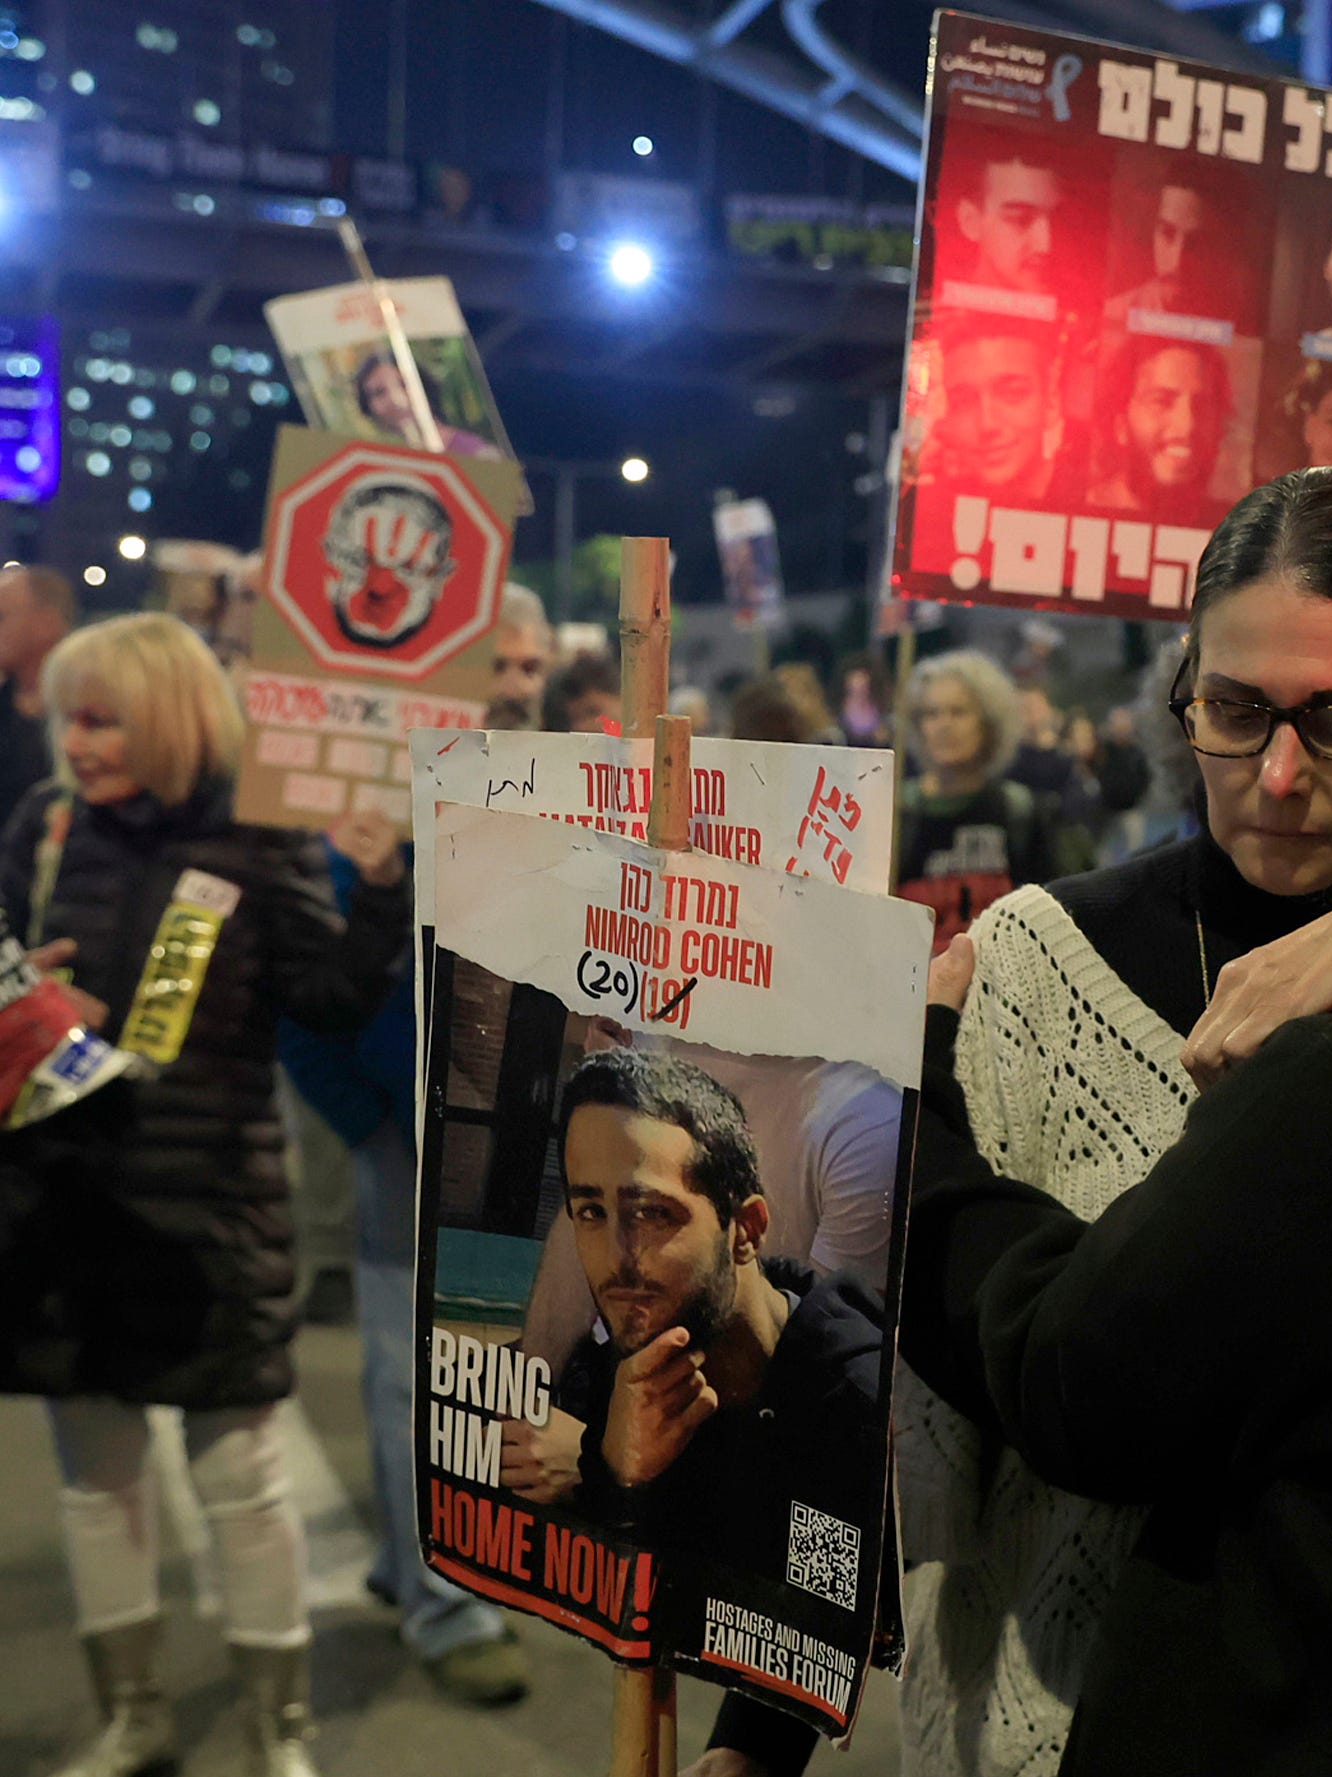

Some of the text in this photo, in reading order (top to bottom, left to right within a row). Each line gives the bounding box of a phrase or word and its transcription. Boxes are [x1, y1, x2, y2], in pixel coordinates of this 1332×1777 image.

[1098, 59, 1267, 164] כולם
[950, 495, 1212, 610] היום!
[620, 862, 740, 929] נמרוד כהן
[577, 951, 638, 1014] (20)
[585, 904, 773, 989] NIMROD COHEN
[430, 1326, 551, 1427] BRING
[430, 1400, 503, 1488] HIM
[430, 1478, 653, 1632] HOME NOW!
[704, 1620, 852, 1717] FAMILIES FORUM
[706, 1597, 857, 1680] HOSTAGES AND MISSING
